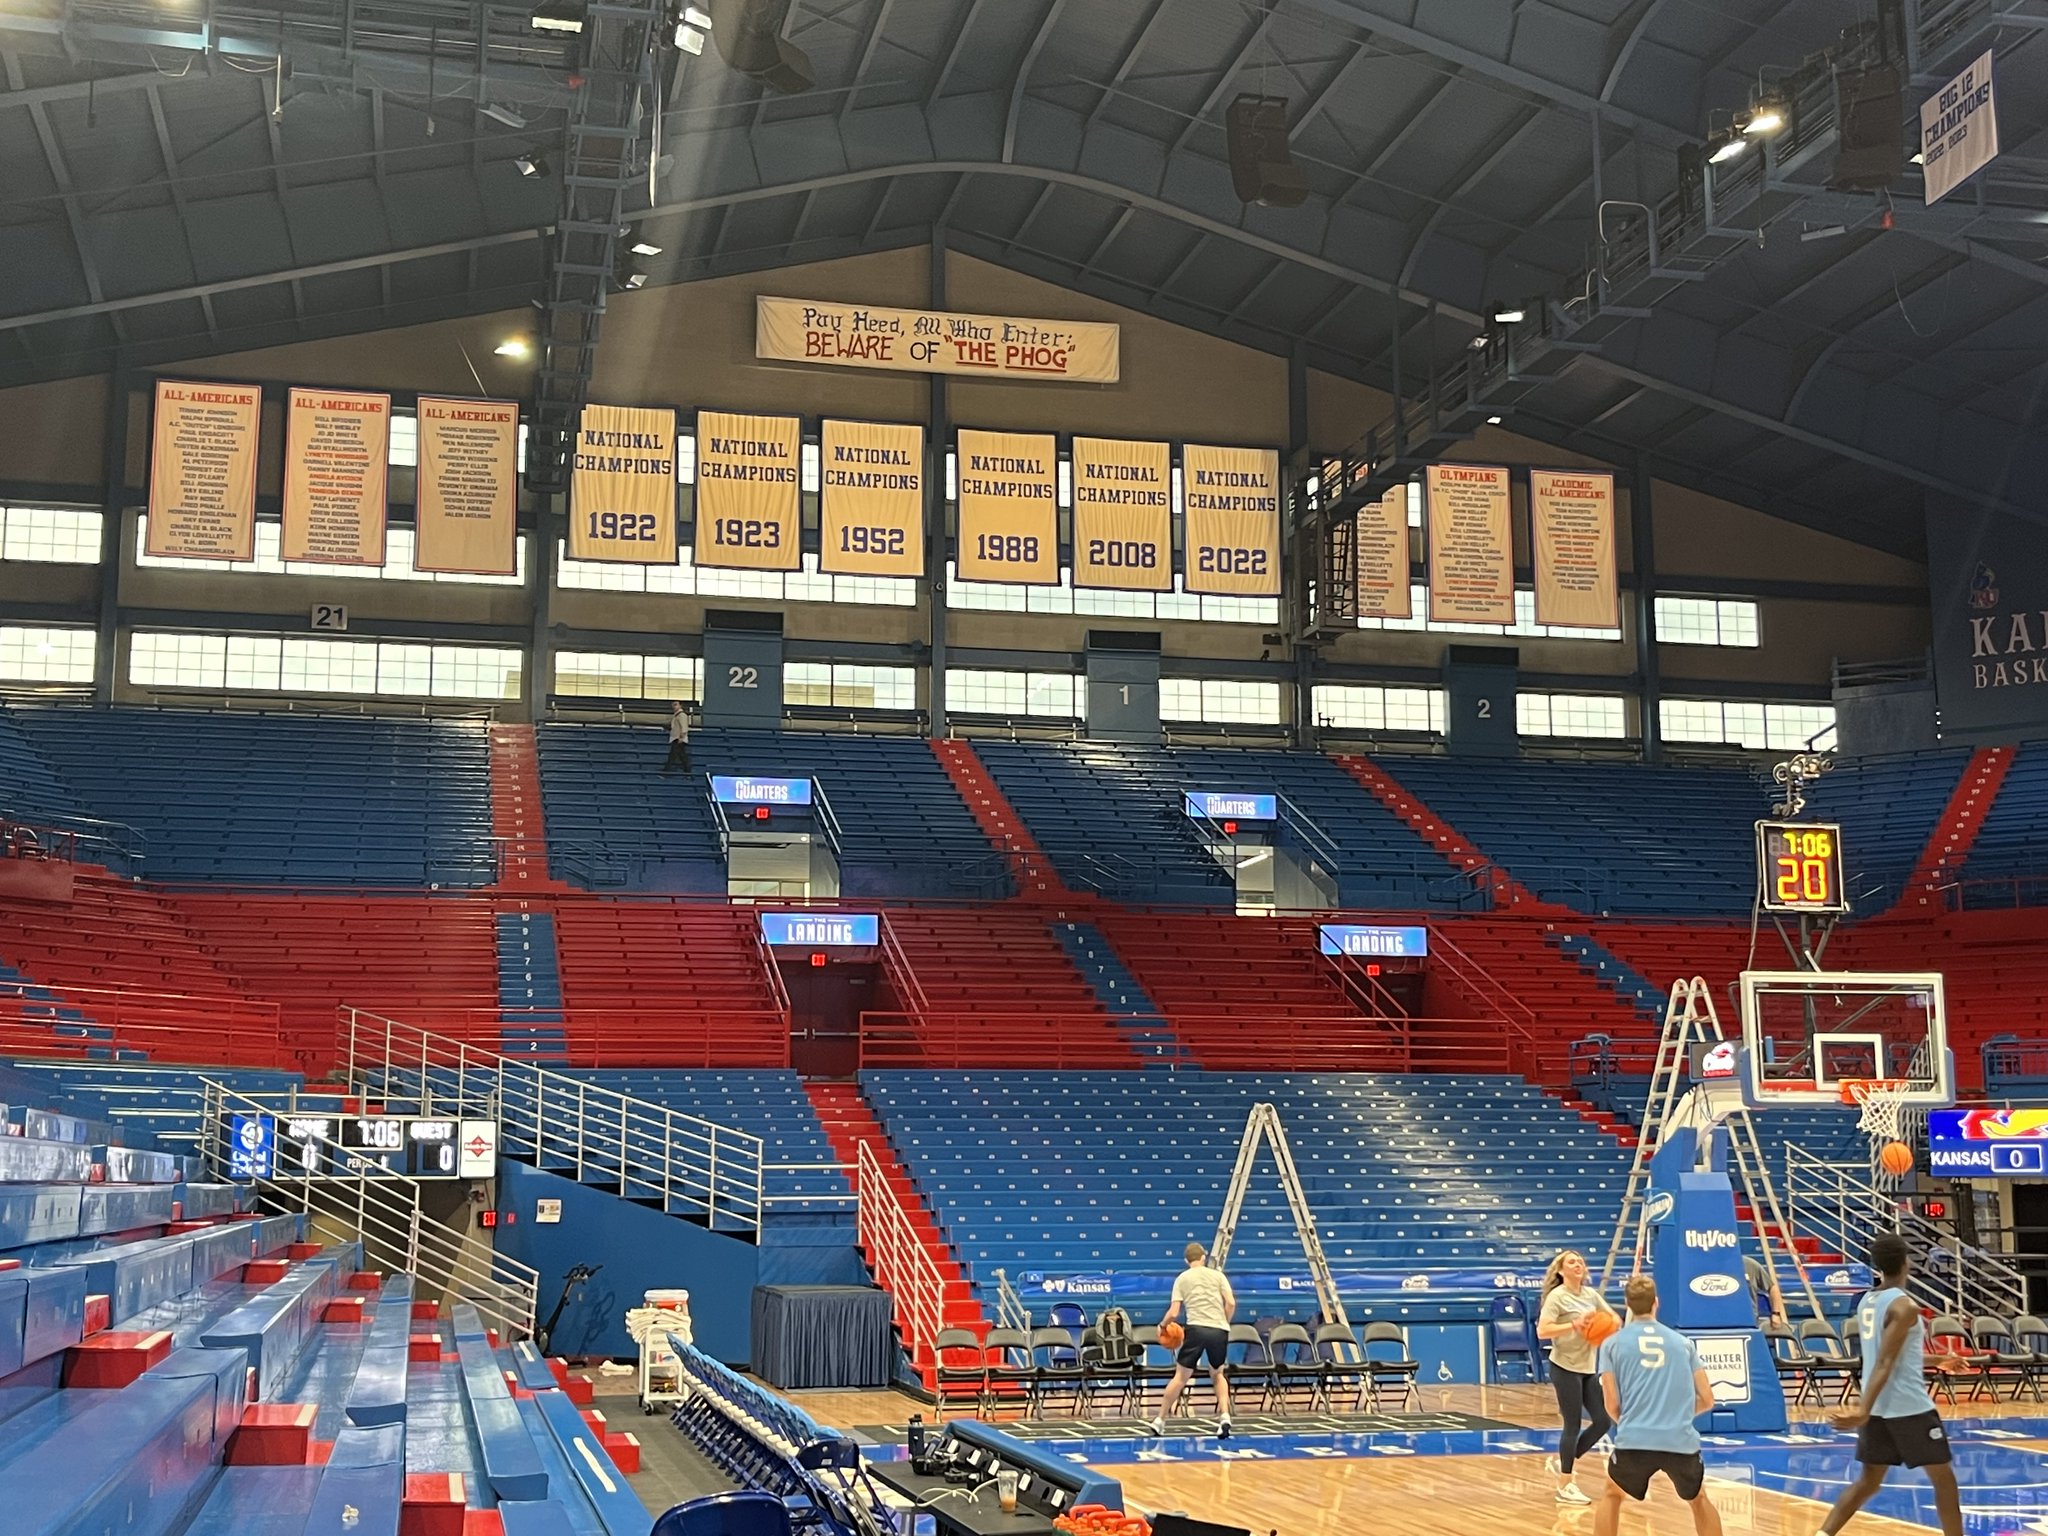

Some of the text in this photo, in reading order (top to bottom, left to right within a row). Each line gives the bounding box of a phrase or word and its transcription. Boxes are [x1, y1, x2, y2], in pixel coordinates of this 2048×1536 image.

[1939, 70, 1974, 114] BIG 12
[1924, 81, 1990, 148] CHAMPIONS
[803, 308, 1073, 347] Pay Heed, All Who Enter:
[805, 331, 1076, 368] BEWARE OF "THE PHOG"
[164, 390, 253, 405] ALL-AMERICANS
[296, 398, 382, 412] ALL-AMERICANS
[426, 408, 511, 422] ALL-AMERICANS
[585, 430, 663, 450] NATIONAL
[710, 438, 788, 458] NATIONAL
[574, 454, 671, 475] CHAMPIONS
[834, 446, 911, 466] NATIONAL
[970, 455, 1045, 475] NATIONAL
[701, 462, 796, 483] CHAMPIONS
[825, 470, 919, 491] CHAMPIONS
[1085, 463, 1159, 483] NATIONAL
[1196, 470, 1269, 488] NATIONAL
[1440, 470, 1497, 482] OLYMPIANS
[962, 478, 1053, 499] CHAMPIONS
[1540, 488, 1605, 499] ALL-AMERICANS
[1552, 479, 1592, 489] ACADEMIC
[1077, 486, 1167, 507] CHAMPIONS
[1188, 493, 1276, 512] CHAMPIONS
[588, 511, 656, 541] 1922
[714, 518, 780, 549] 1923
[840, 525, 905, 555] 1952
[977, 533, 1039, 563] 1988
[1089, 539, 1156, 568] 2008
[1198, 546, 1267, 575] 2022
[316, 606, 343, 627] 21
[728, 666, 758, 688] 22
[1119, 685, 1128, 705] 1
[1477, 699, 1491, 718] 2
[735, 781, 788, 800] QUARTERS
[1207, 797, 1256, 816] QUARTERS
[1783, 833, 1831, 857] 7:06
[1777, 858, 1826, 900] 20
[787, 923, 852, 942] LANDING
[1344, 934, 1404, 953] LANDING
[525, 958, 530, 966] 7
[525, 973, 531, 981] 6
[1109, 980, 1115, 988] 6
[527, 989, 533, 997] 5
[50, 1008, 55, 1016] 3
[530, 1042, 537, 1051] 2
[1156, 1046, 1162, 1054] 2
[357, 1120, 400, 1147] 7:06
[410, 1122, 453, 1139] GUEST
[346, 1158, 374, 1168] PEROD
[439, 1144, 453, 1171] 0
[1930, 1150, 2023, 1167] KANSAS 0
[1067, 1282, 1111, 1293] Kansas
[1517, 1278, 1544, 1288] Kans
[1700, 1279, 1728, 1291] Ford
[1860, 1308, 1876, 1340] 9
[1638, 1336, 1665, 1368] 5
[1700, 1354, 1742, 1363] SHELTER
